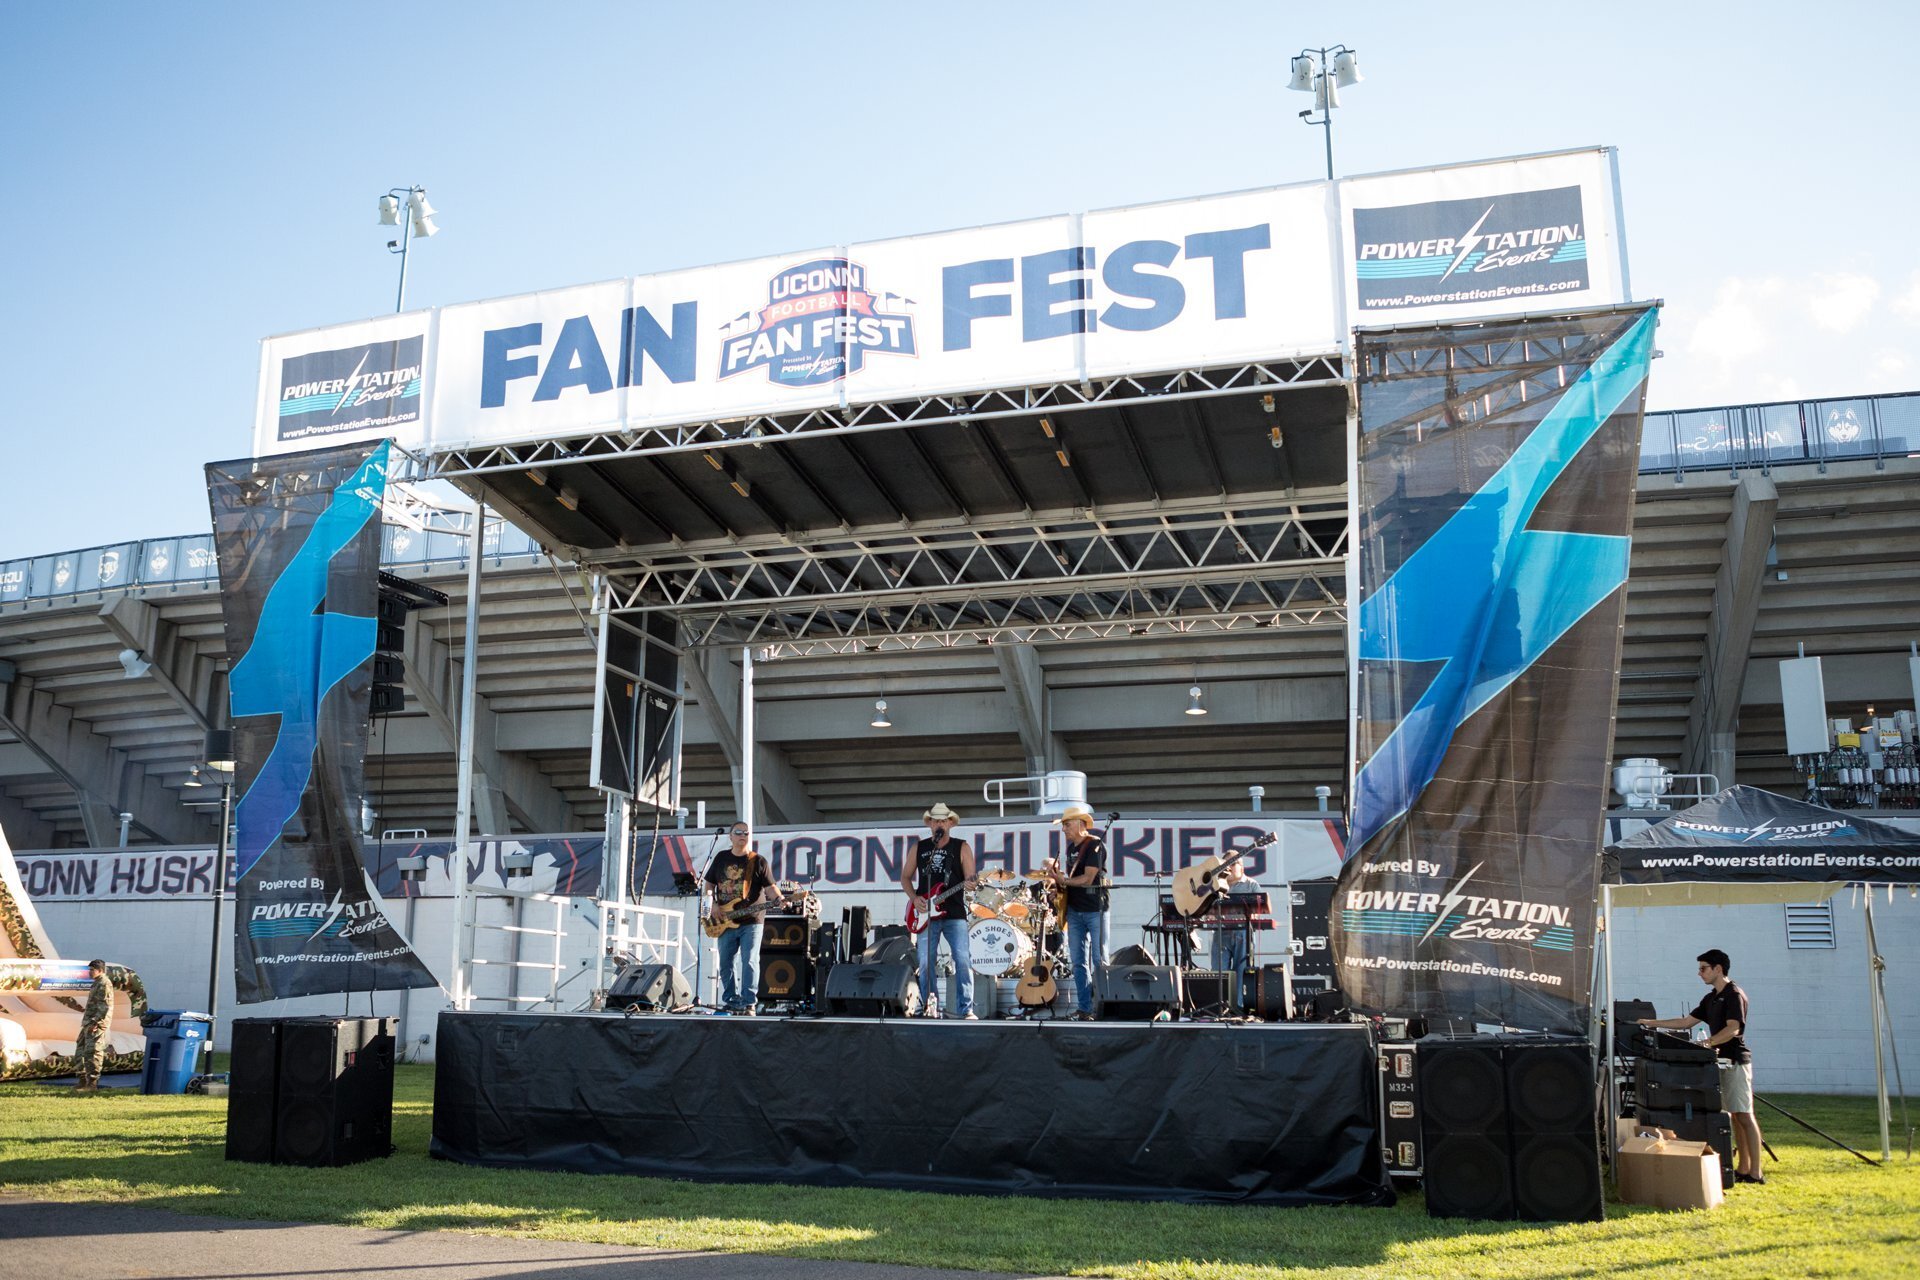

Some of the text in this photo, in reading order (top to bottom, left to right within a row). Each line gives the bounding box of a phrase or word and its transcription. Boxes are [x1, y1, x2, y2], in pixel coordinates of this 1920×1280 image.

[1474, 246, 1553, 272] Events
[773, 268, 860, 299] UCONN
[1366, 279, 1580, 306] www.PowerstationEvents.com
[480, 223, 1271, 409] FAN FEST
[772, 293, 861, 319] FOOTBALL
[728, 316, 905, 370] FAN FEST
[783, 356, 805, 364] Presented
[353, 383, 405, 406] Events
[283, 412, 416, 439] www.PowerstationEvents.com
[1768, 830, 1830, 841] Events
[974, 826, 1266, 877] HUKIES
[1641, 853, 1920, 868] www.PowerstationEvents.com
[1361, 859, 1440, 876] owered By
[339, 913, 388, 938] Events
[970, 926, 1012, 939] NO SHOES
[1450, 917, 1539, 940] Events
[972, 957, 994, 965] NATION
